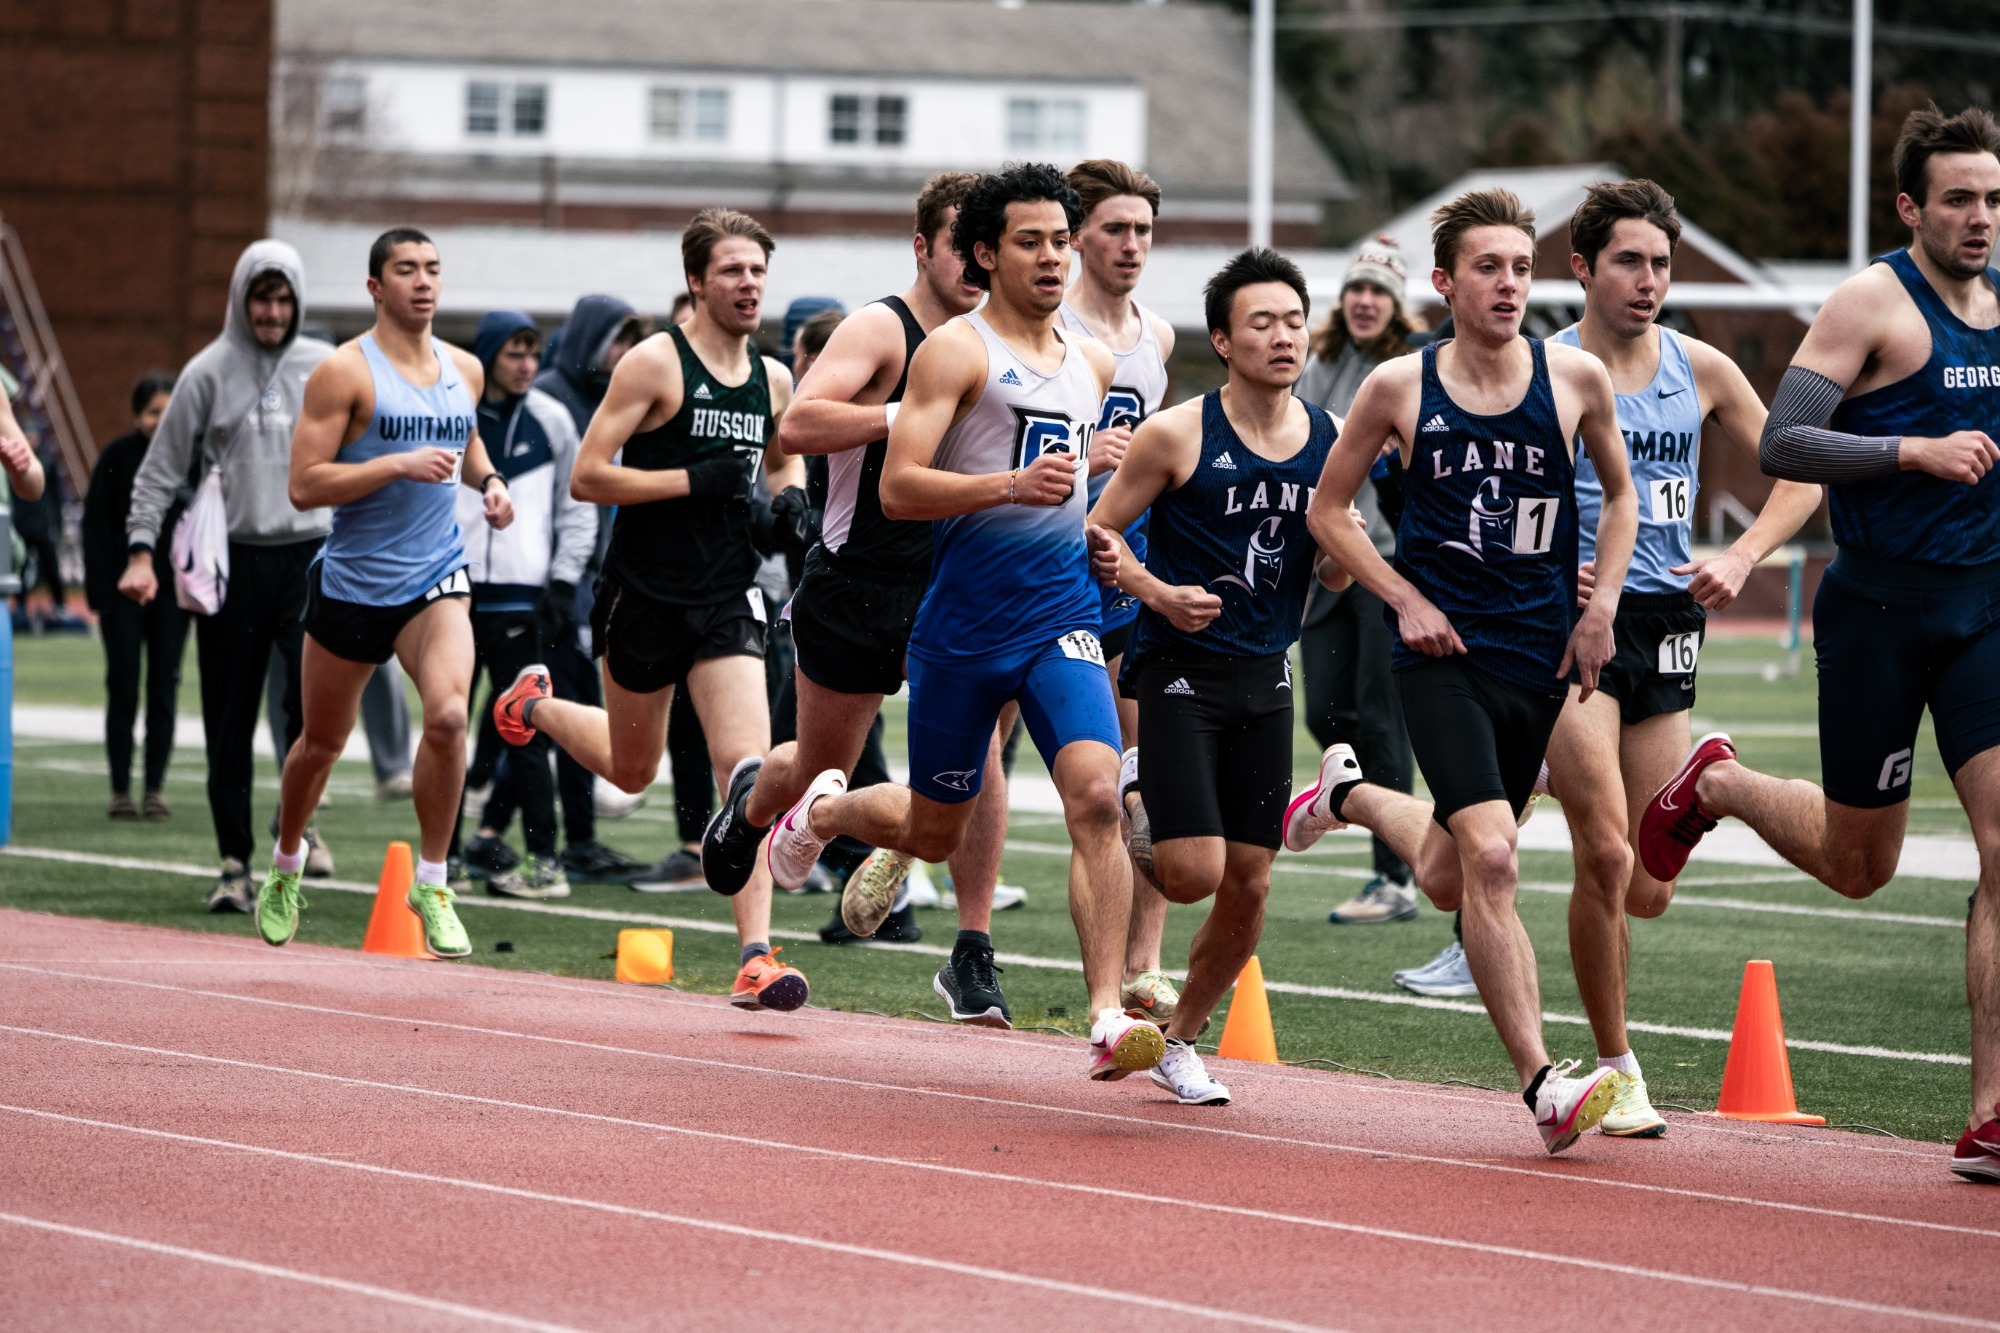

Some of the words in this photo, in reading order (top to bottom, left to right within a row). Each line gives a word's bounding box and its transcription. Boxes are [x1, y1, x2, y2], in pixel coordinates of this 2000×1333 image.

[999, 377, 1023, 387] adidas
[1943, 366, 2000, 389] GEORG
[379, 415, 474, 442] WHITMAN
[690, 408, 765, 443] HUSSON
[1421, 424, 1450, 433] adidas
[1212, 461, 1237, 470] adidas
[1432, 440, 1545, 480] LANE
[1659, 480, 1686, 519] 16
[1528, 502, 1547, 551] 1
[1066, 632, 1099, 662] 10
[1666, 633, 1694, 670] 16
[1164, 687, 1195, 695] adidas
